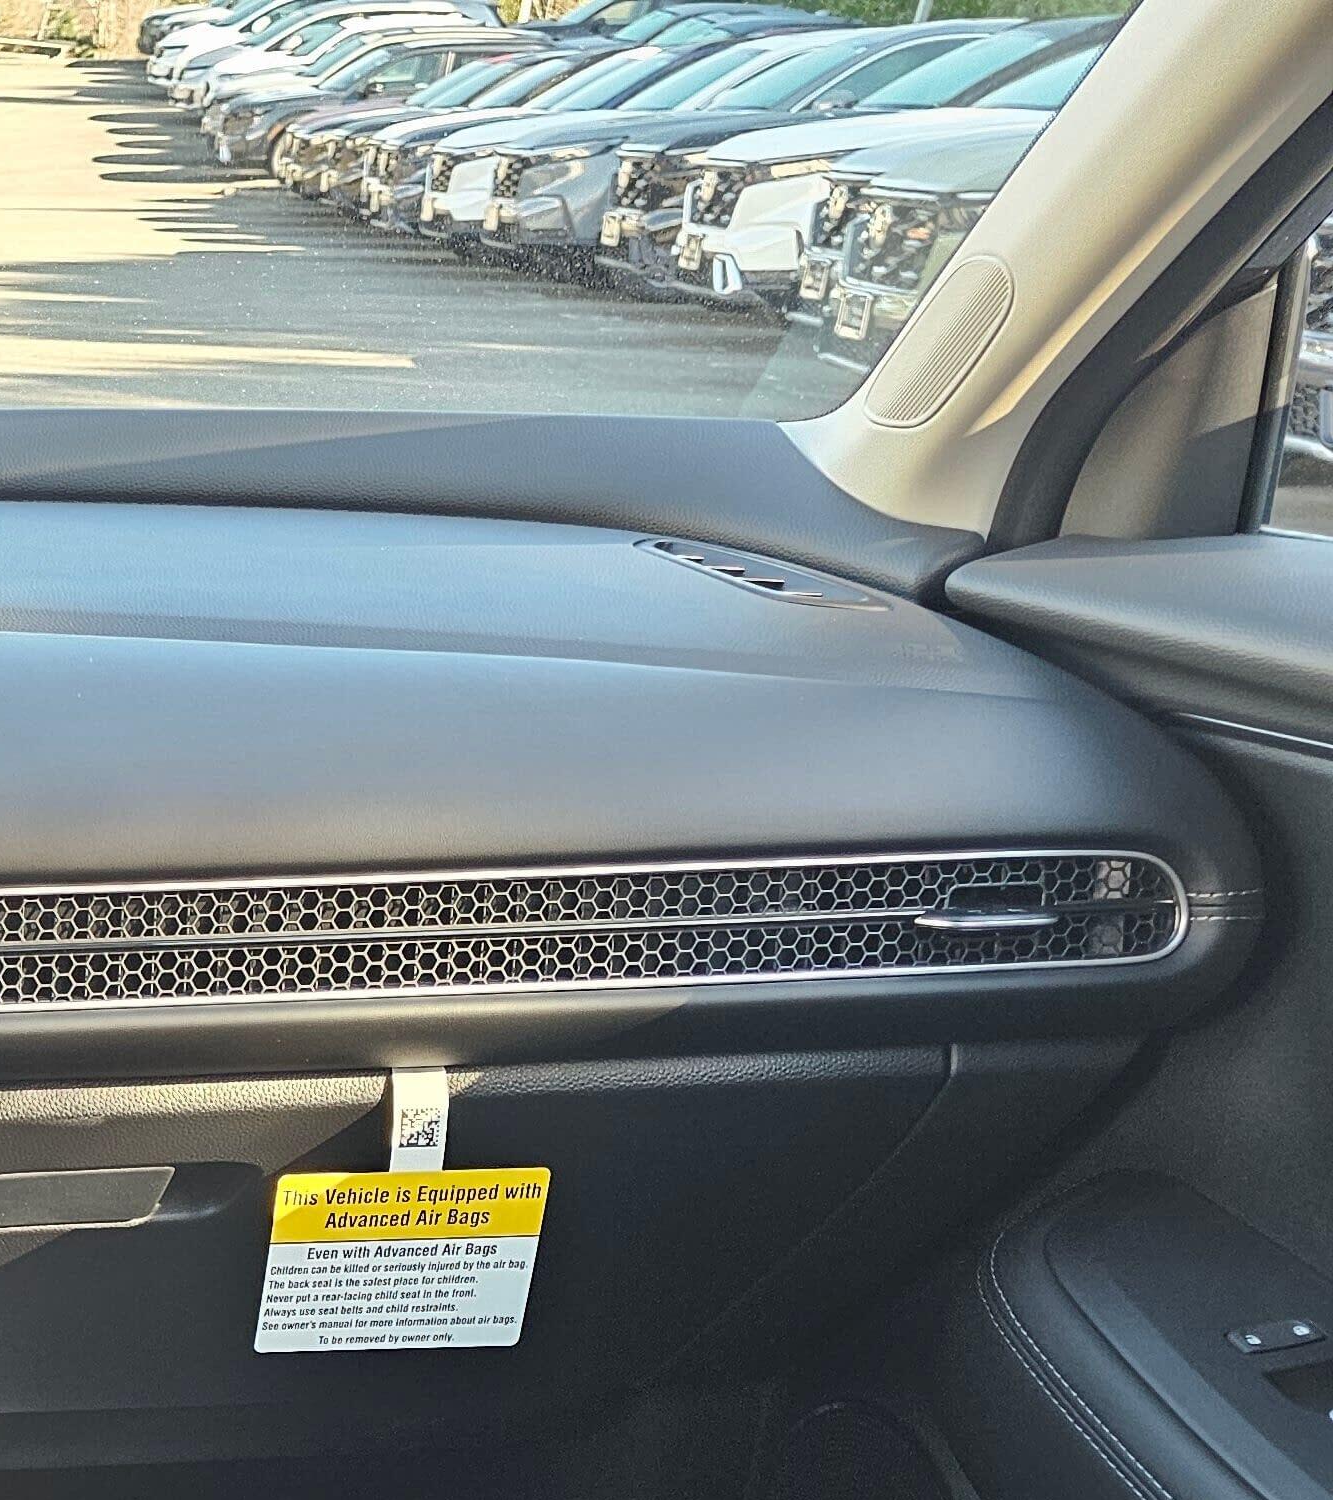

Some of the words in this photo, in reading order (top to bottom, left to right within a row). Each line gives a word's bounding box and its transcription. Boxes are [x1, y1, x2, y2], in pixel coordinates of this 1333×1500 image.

[283, 1190, 319, 1206] This
[325, 1187, 389, 1205] Vehicle
[396, 1187, 411, 1202] is
[417, 1184, 500, 1205] Equipped
[505, 1183, 542, 1199] with
[325, 1210, 411, 1229] Advanced
[415, 1209, 442, 1226] Air
[447, 1208, 491, 1228] Bags
[307, 1248, 338, 1260] Even
[342, 1246, 370, 1259] with
[374, 1243, 440, 1258] Advanced
[441, 1243, 461, 1256] Air
[465, 1243, 498, 1257] Bags
[271, 1264, 309, 1275] Children
[311, 1265, 328, 1274] can
[330, 1263, 341, 1274] be
[344, 1263, 369, 1273] killed
[371, 1264, 382, 1273] or
[384, 1261, 426, 1273] seriously
[428, 1260, 460, 1272] injured
[463, 1260, 474, 1272] by
[476, 1259, 491, 1269] the
[493, 1259, 507, 1269] air
[508, 1259, 529, 1271] bag.
[269, 1280, 285, 1290] The
[288, 1279, 310, 1289] back
[334, 1278, 343, 1288] is
[345, 1278, 360, 1288] the
[393, 1276, 419, 1288] place
[421, 1275, 435, 1285] for
[437, 1275, 478, 1285] children.
[266, 1294, 293, 1304] Never
[295, 1293, 311, 1305] put
[312, 1294, 319, 1302] a
[321, 1291, 372, 1303] rear-facing
[374, 1290, 398, 1300] child
[423, 1289, 432, 1299] in
[434, 1288, 449, 1298] the
[264, 1307, 297, 1318] Always
[299, 1308, 316, 1316] use
[365, 1304, 384, 1314] and
[385, 1303, 408, 1314] child
[262, 1321, 279, 1331] See
[281, 1320, 316, 1330] owner's
[318, 1319, 353, 1330] manual
[354, 1319, 368, 1329] for
[369, 1319, 393, 1328] more
[395, 1316, 448, 1327] information
[450, 1316, 476, 1326] about
[477, 1316, 491, 1325] air
[493, 1315, 517, 1326] bags.
[319, 1335, 329, 1345] To
[331, 1335, 343, 1345] be
[345, 1334, 386, 1344] removed
[388, 1333, 399, 1343] by
[401, 1334, 430, 1343] owner
[432, 1333, 455, 1343] only.
